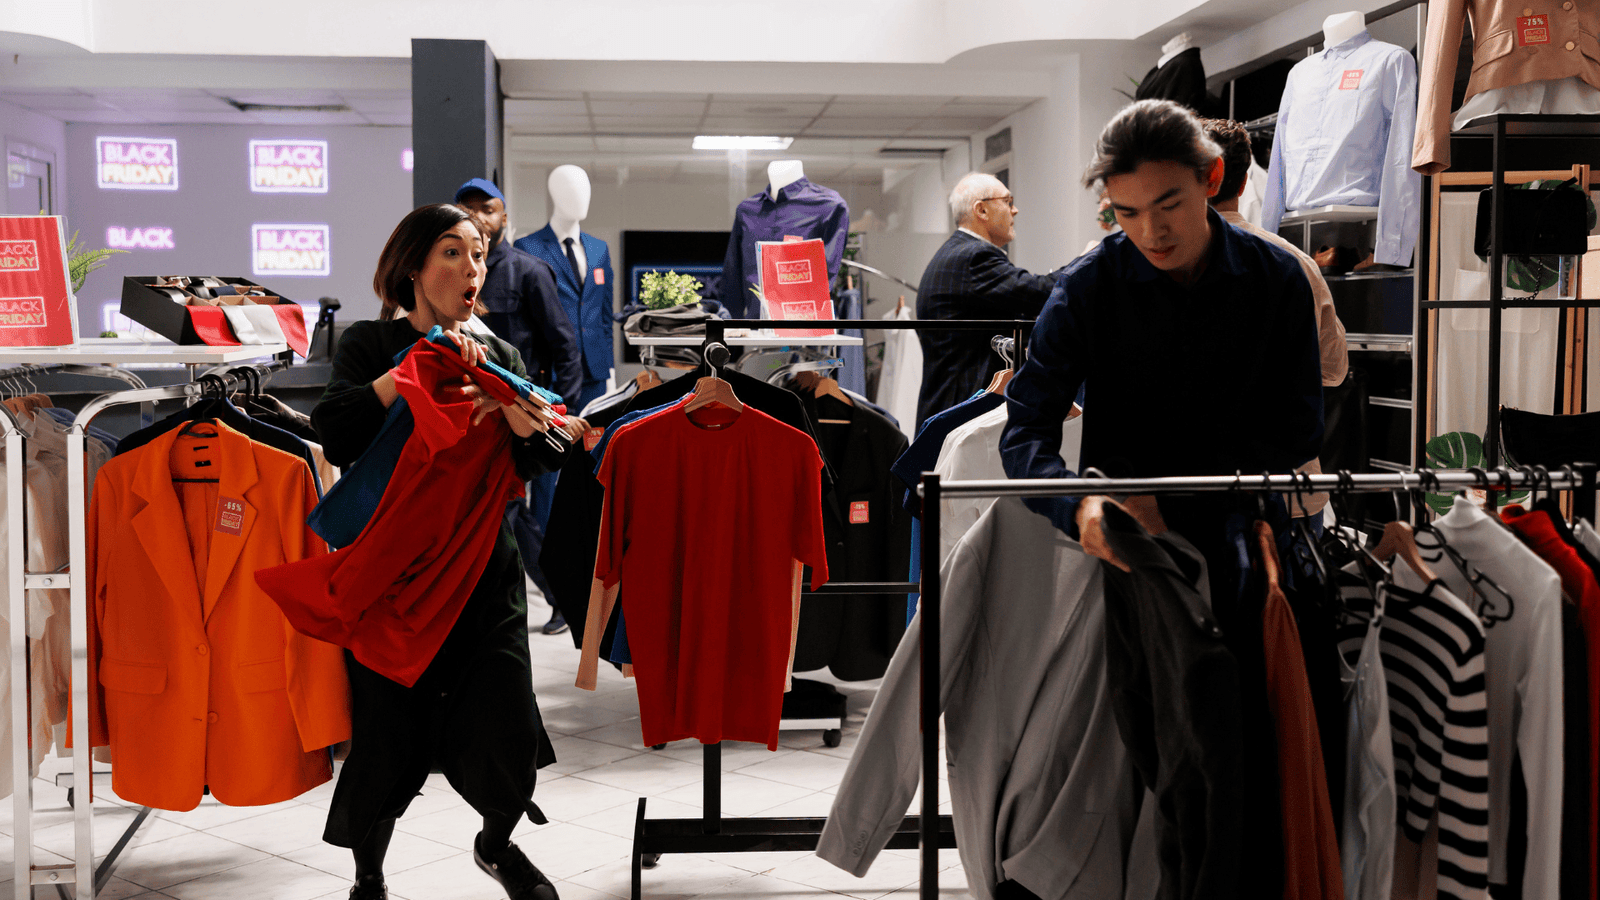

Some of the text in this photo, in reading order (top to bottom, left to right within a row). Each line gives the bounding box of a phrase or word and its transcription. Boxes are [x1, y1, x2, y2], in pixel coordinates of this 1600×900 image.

[1523, 17, 1544, 26] -75%
[105, 143, 171, 164] BLACK
[257, 146, 321, 167] BLACK
[103, 164, 173, 184] FRIDAY
[256, 166, 323, 187] FRIDAY
[107, 227, 175, 249] BLACK
[260, 230, 323, 251] BLACK
[0, 244, 33, 255] ACK
[0, 256, 35, 268] RIDAY
[258, 250, 325, 270] FRIDAY
[780, 262, 808, 273] BLACK
[780, 271, 811, 282] FRIDAY
